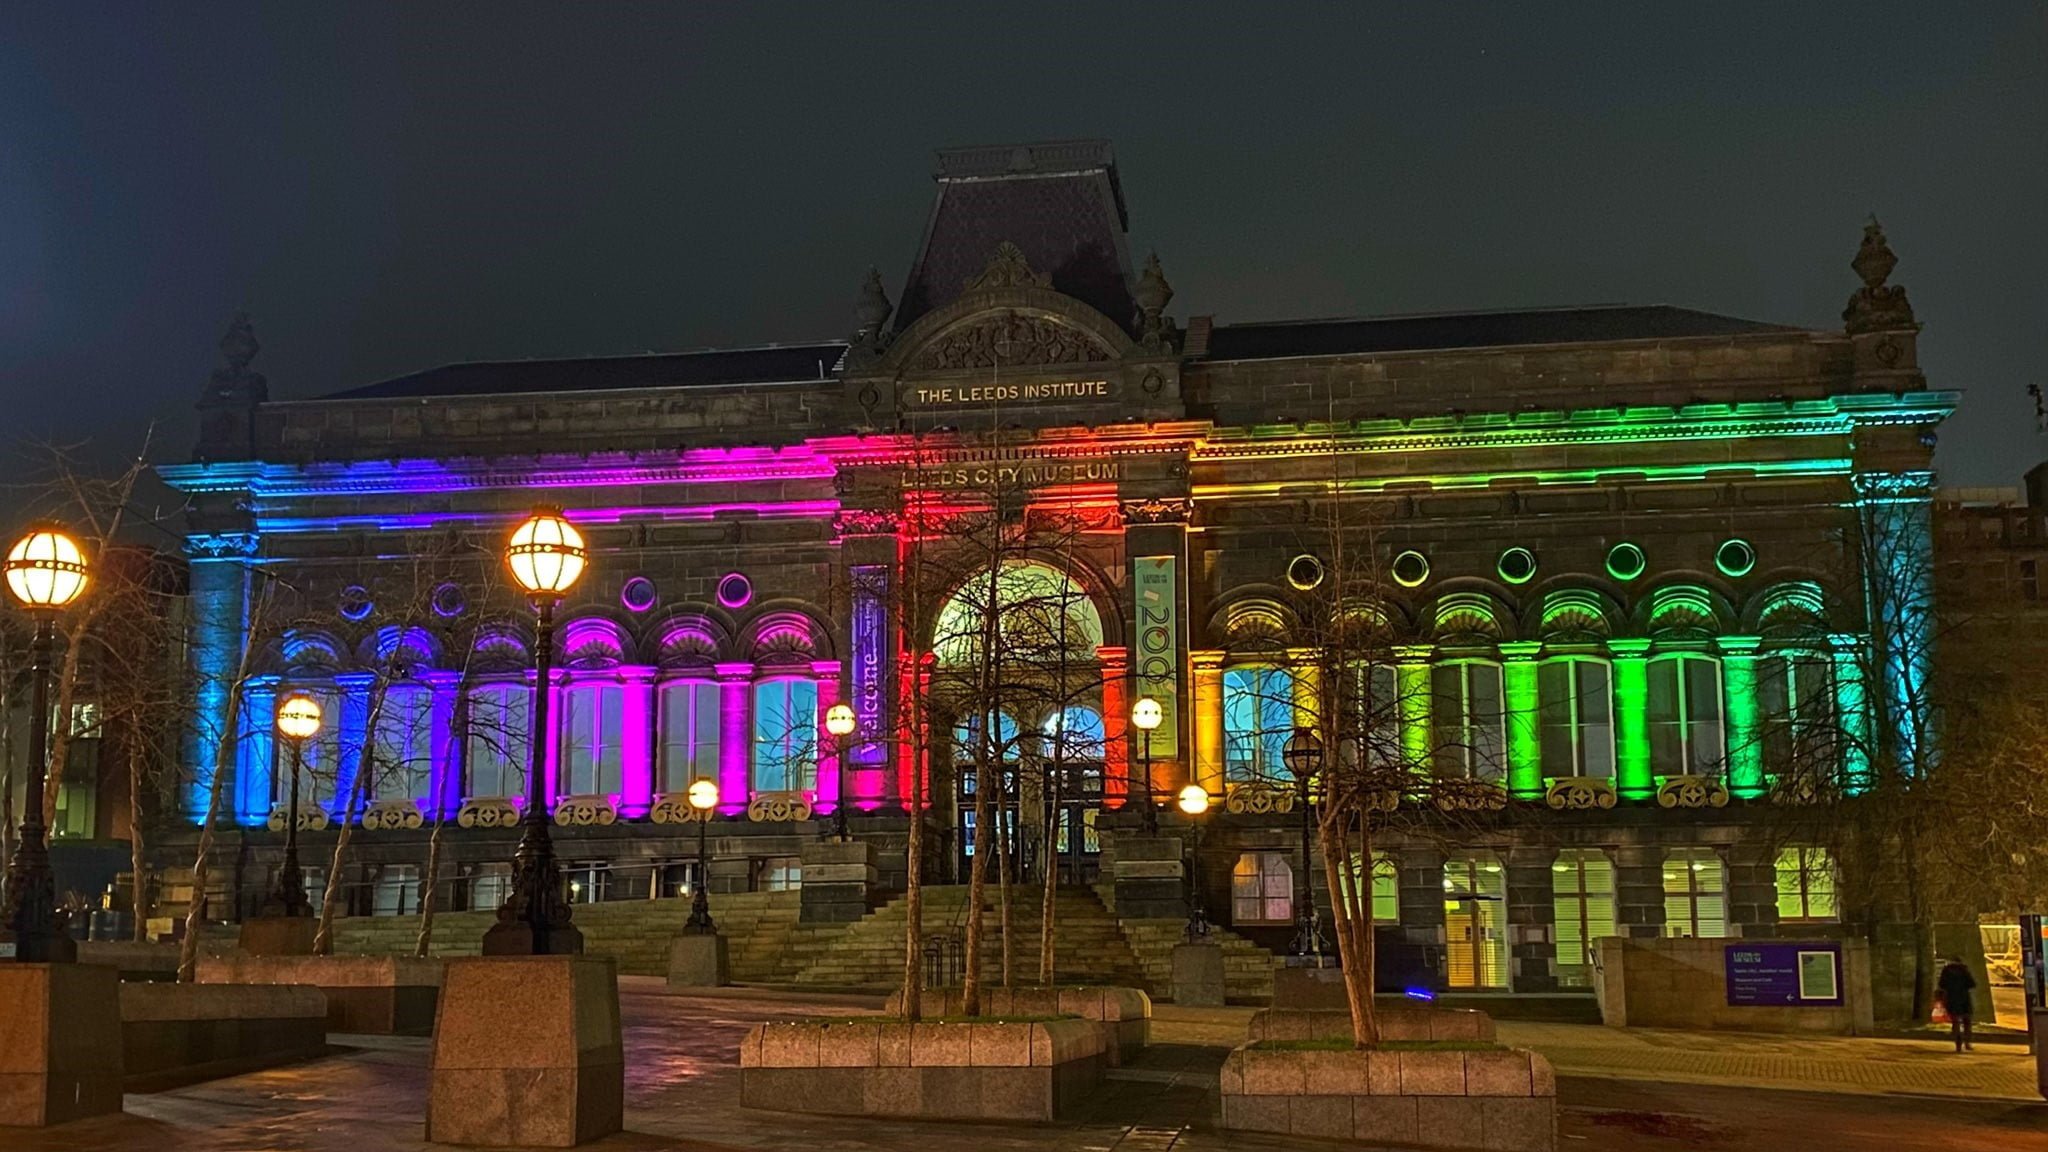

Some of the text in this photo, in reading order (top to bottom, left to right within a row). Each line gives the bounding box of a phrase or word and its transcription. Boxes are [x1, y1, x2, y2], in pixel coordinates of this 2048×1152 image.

[918, 381, 1107, 403] THE LEEDS INSTITUTE
[1026, 463, 1118, 481] MUSEUM
[1142, 607, 1170, 684] 200
